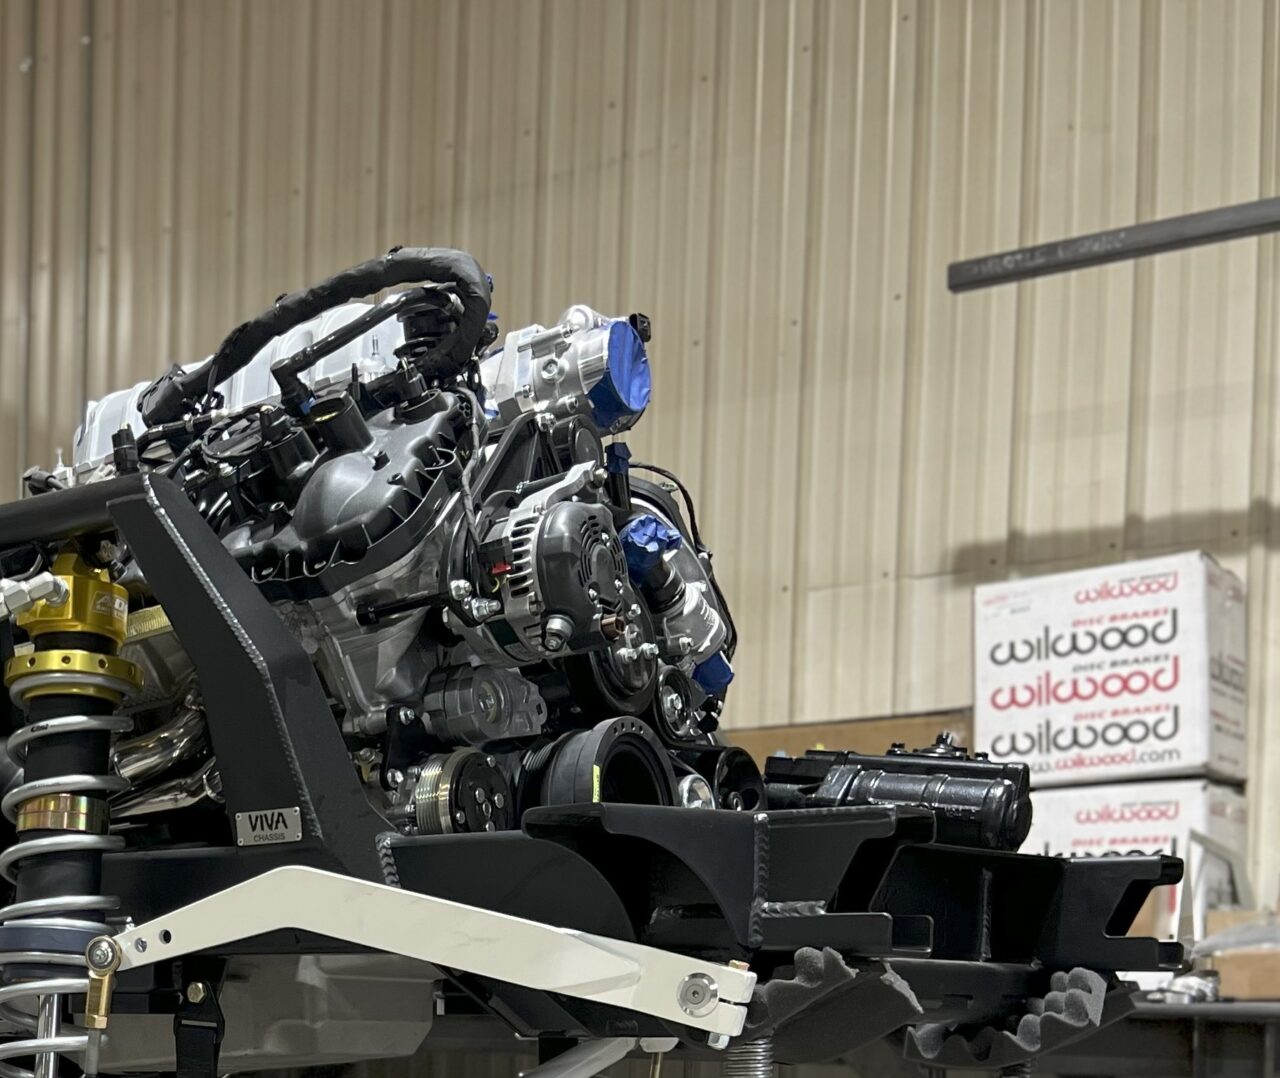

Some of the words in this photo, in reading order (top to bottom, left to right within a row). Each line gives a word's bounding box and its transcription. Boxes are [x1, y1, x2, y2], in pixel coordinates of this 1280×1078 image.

[990, 607, 1178, 666] wilwood
[990, 655, 1179, 711] wilwood
[991, 705, 1179, 758] wilwood
[248, 811, 288, 832] VIVA
[253, 832, 286, 842] CHASSIS
